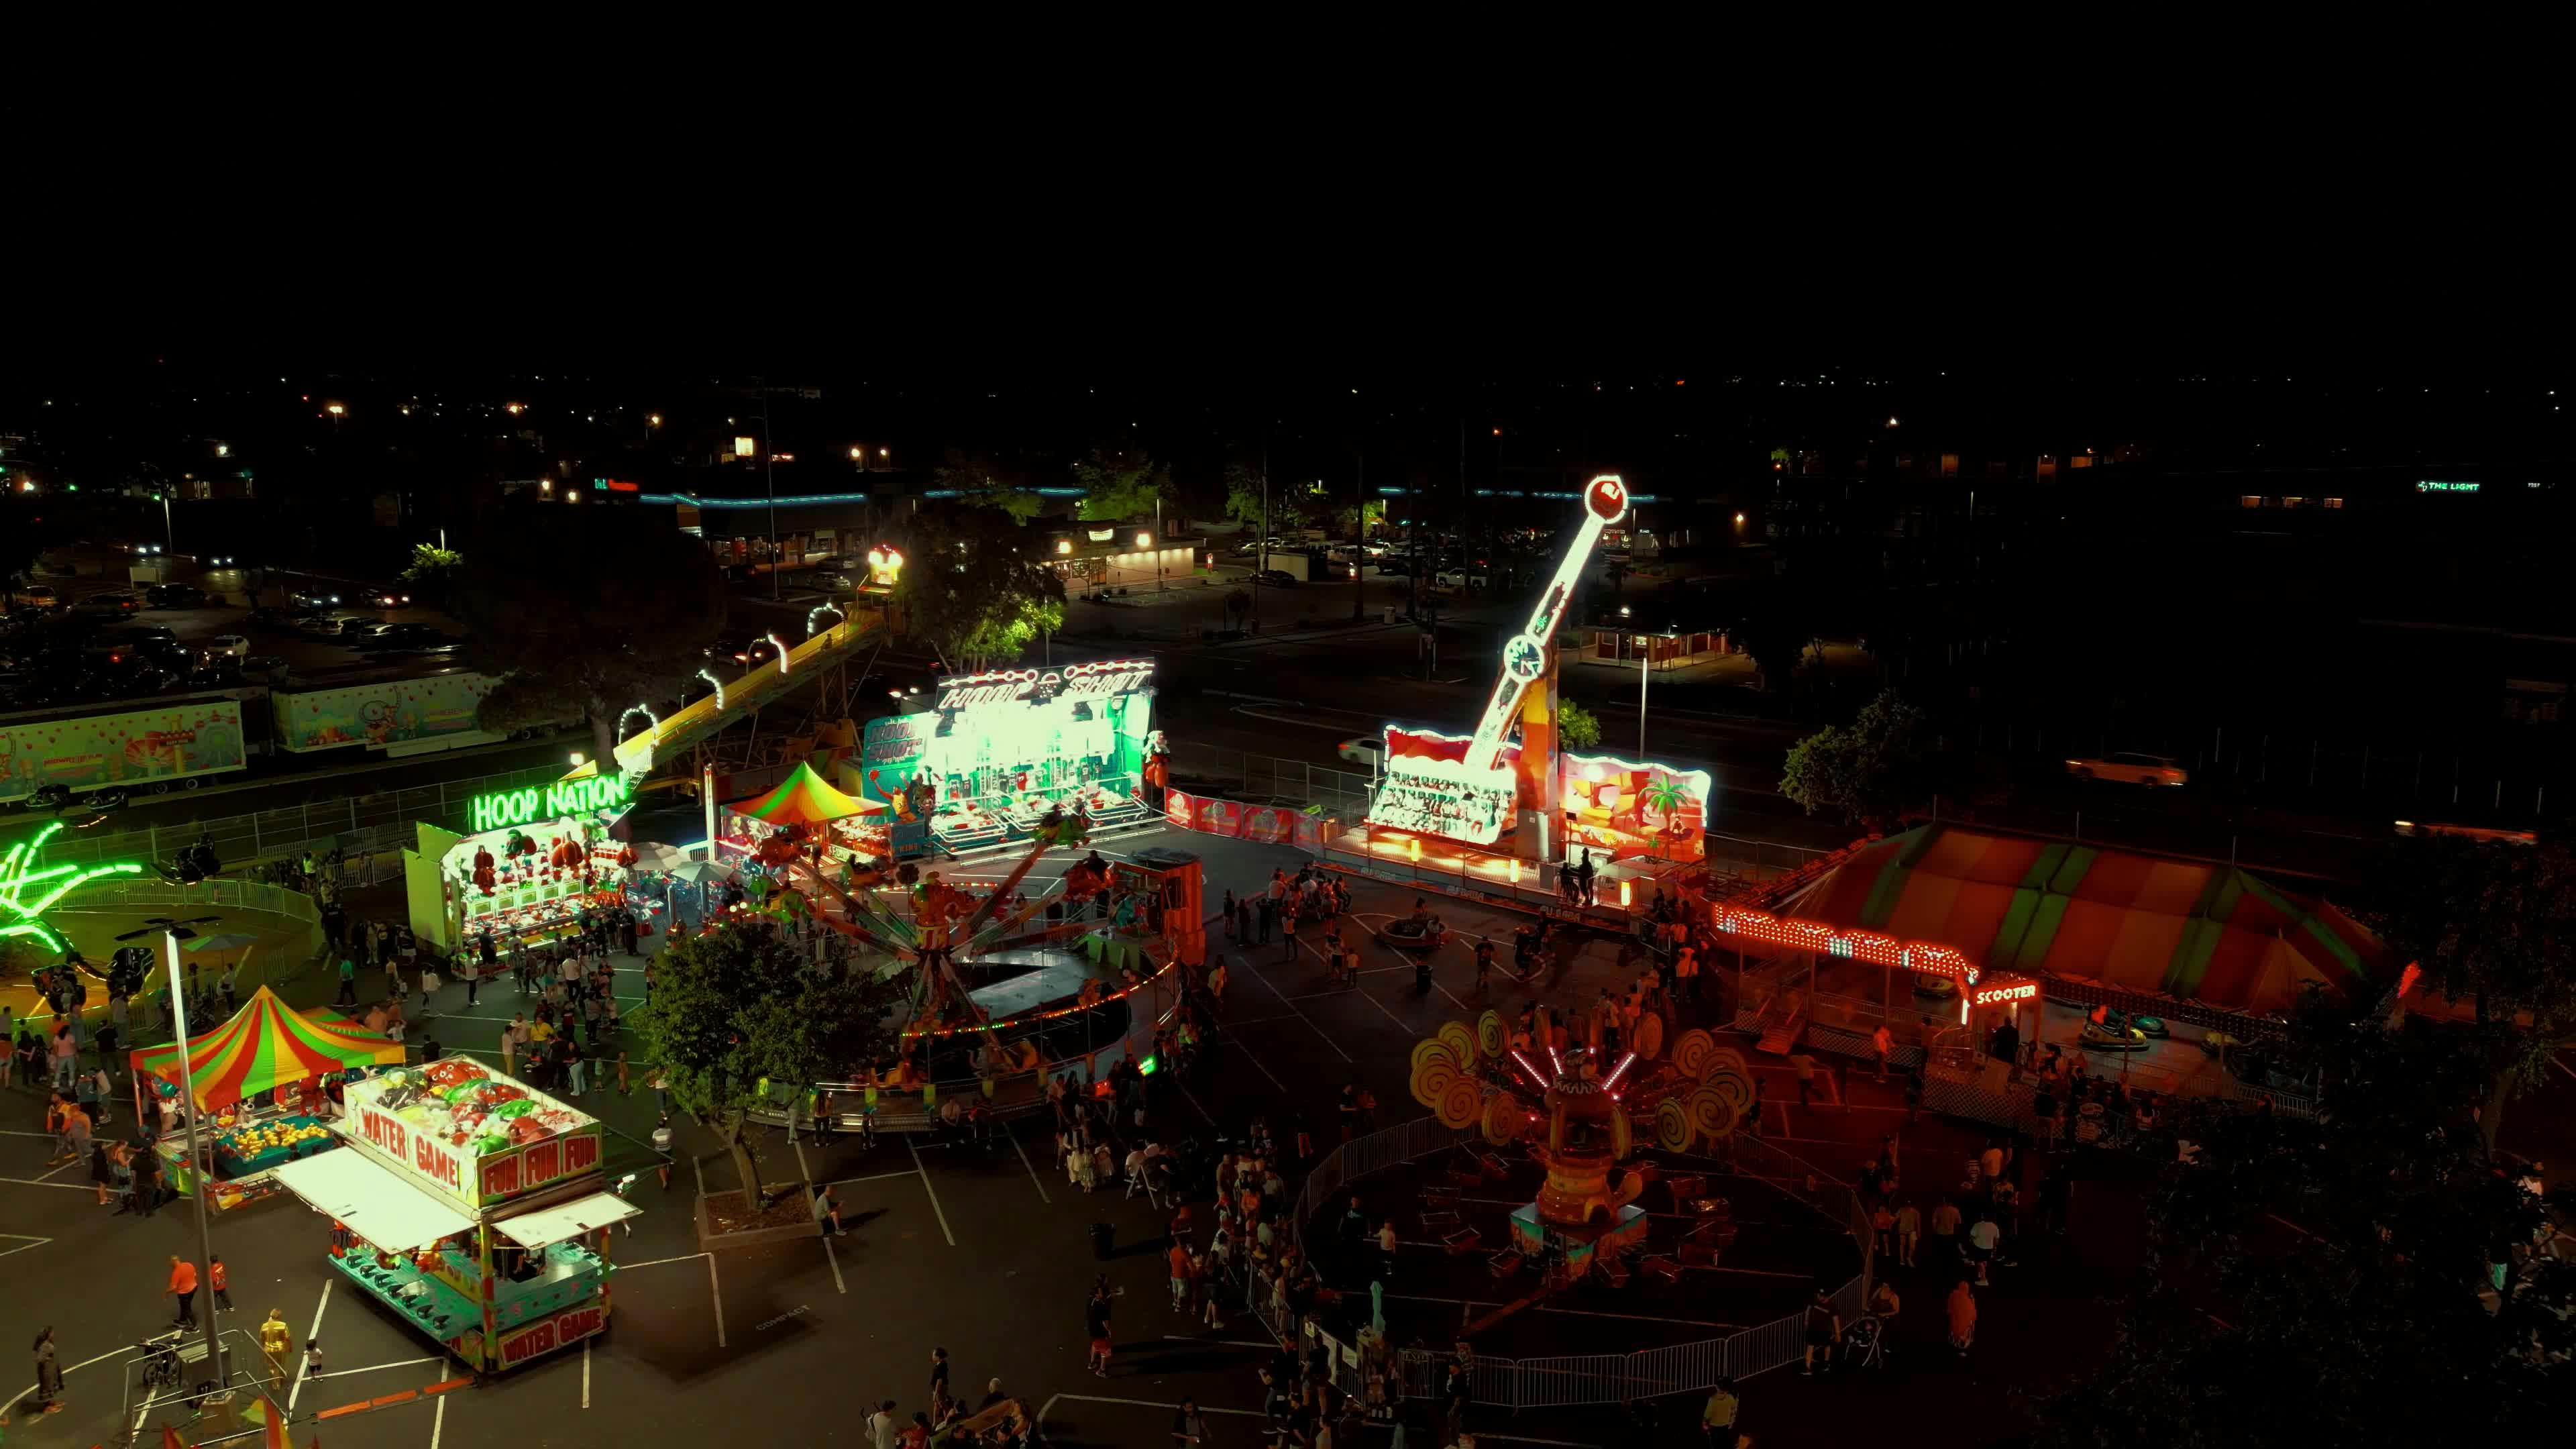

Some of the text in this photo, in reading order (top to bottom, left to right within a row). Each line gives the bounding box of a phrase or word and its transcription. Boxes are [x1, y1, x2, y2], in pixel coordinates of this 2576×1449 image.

[869, 738, 923, 760] SHOT
[474, 771, 627, 832] HOOP NATION
[1976, 984, 2036, 1004] SCOOTER
[361, 1108, 407, 1161] WATER
[484, 1136, 597, 1195] FUN FUN FUN
[503, 1322, 555, 1363] WATER
[559, 1308, 602, 1342] GAME
